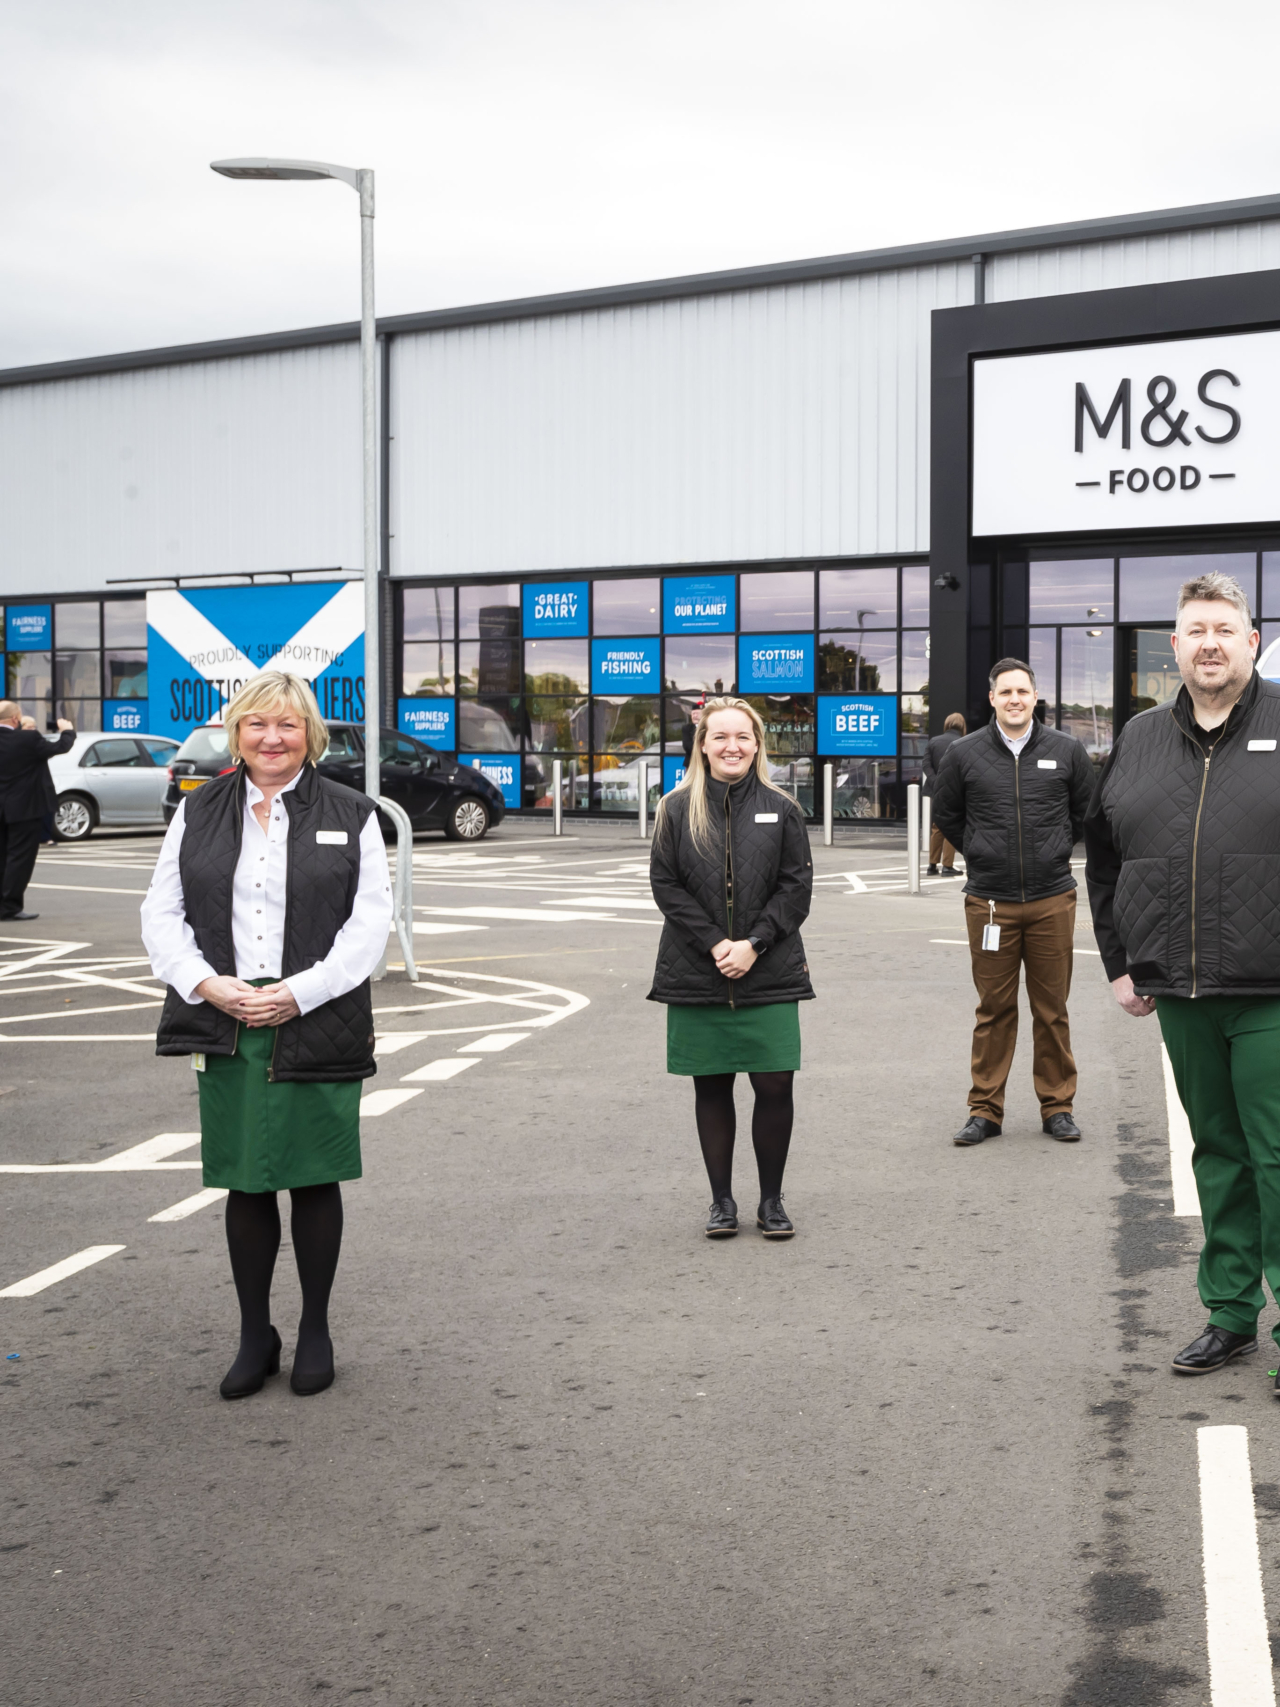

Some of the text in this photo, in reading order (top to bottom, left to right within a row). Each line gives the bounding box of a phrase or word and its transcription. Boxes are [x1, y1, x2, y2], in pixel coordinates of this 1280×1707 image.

[1073, 368, 1242, 453] M&S
[1108, 465, 1202, 495] FOOD
[538, 593, 574, 605] GREAT
[674, 595, 727, 605] PROTECTING
[534, 604, 578, 619] DAIRY
[674, 603, 727, 617] OUR PLANET
[189, 643, 345, 670] PROUDLY SUPPORTING
[607, 651, 645, 661] FRIENDLY
[752, 649, 804, 661] SCOTTISH
[601, 661, 651, 674] FISHING
[752, 660, 804, 678] SALMON
[841, 703, 874, 712] SCOTTISH
[113, 714, 141, 729] BEEF
[404, 710, 450, 723] FAIRNESS
[414, 722, 445, 731] SUPPLIERS
[835, 715, 880, 732] BEEF
